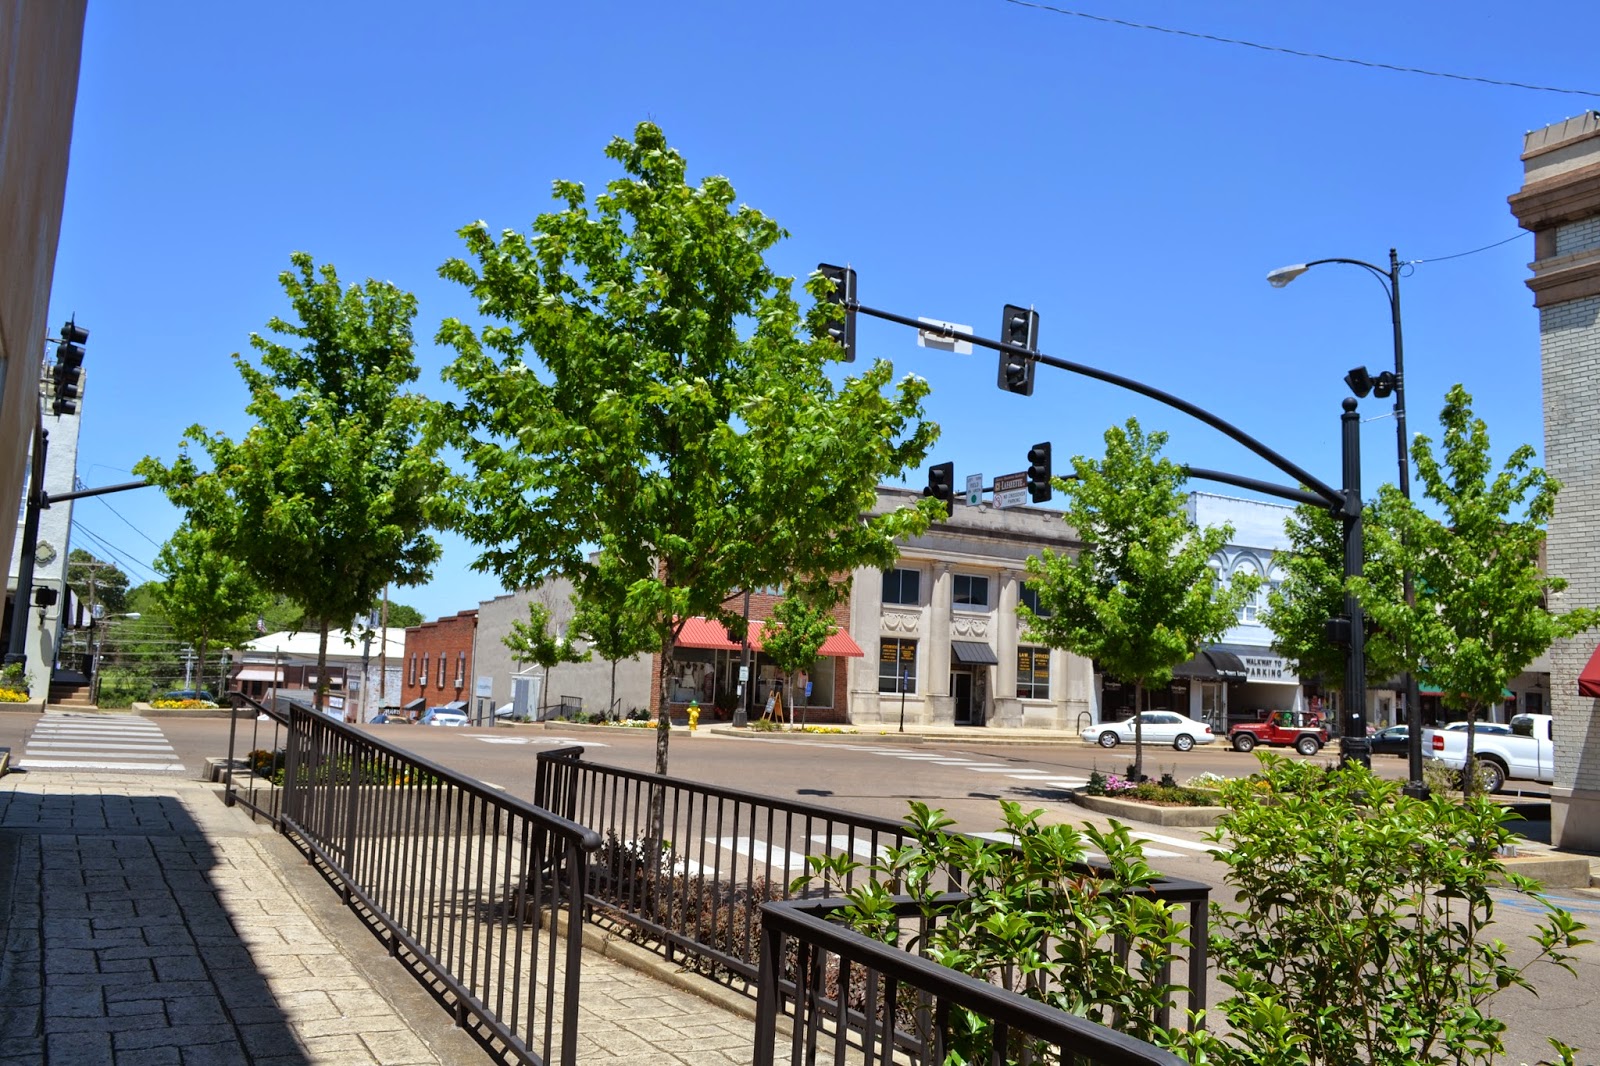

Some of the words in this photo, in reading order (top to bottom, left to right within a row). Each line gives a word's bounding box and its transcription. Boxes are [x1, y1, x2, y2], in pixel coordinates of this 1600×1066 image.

[1246, 658, 1272, 667] WALKWAY
[1274, 660, 1282, 668] TO
[1246, 668, 1282, 678] PARKING
